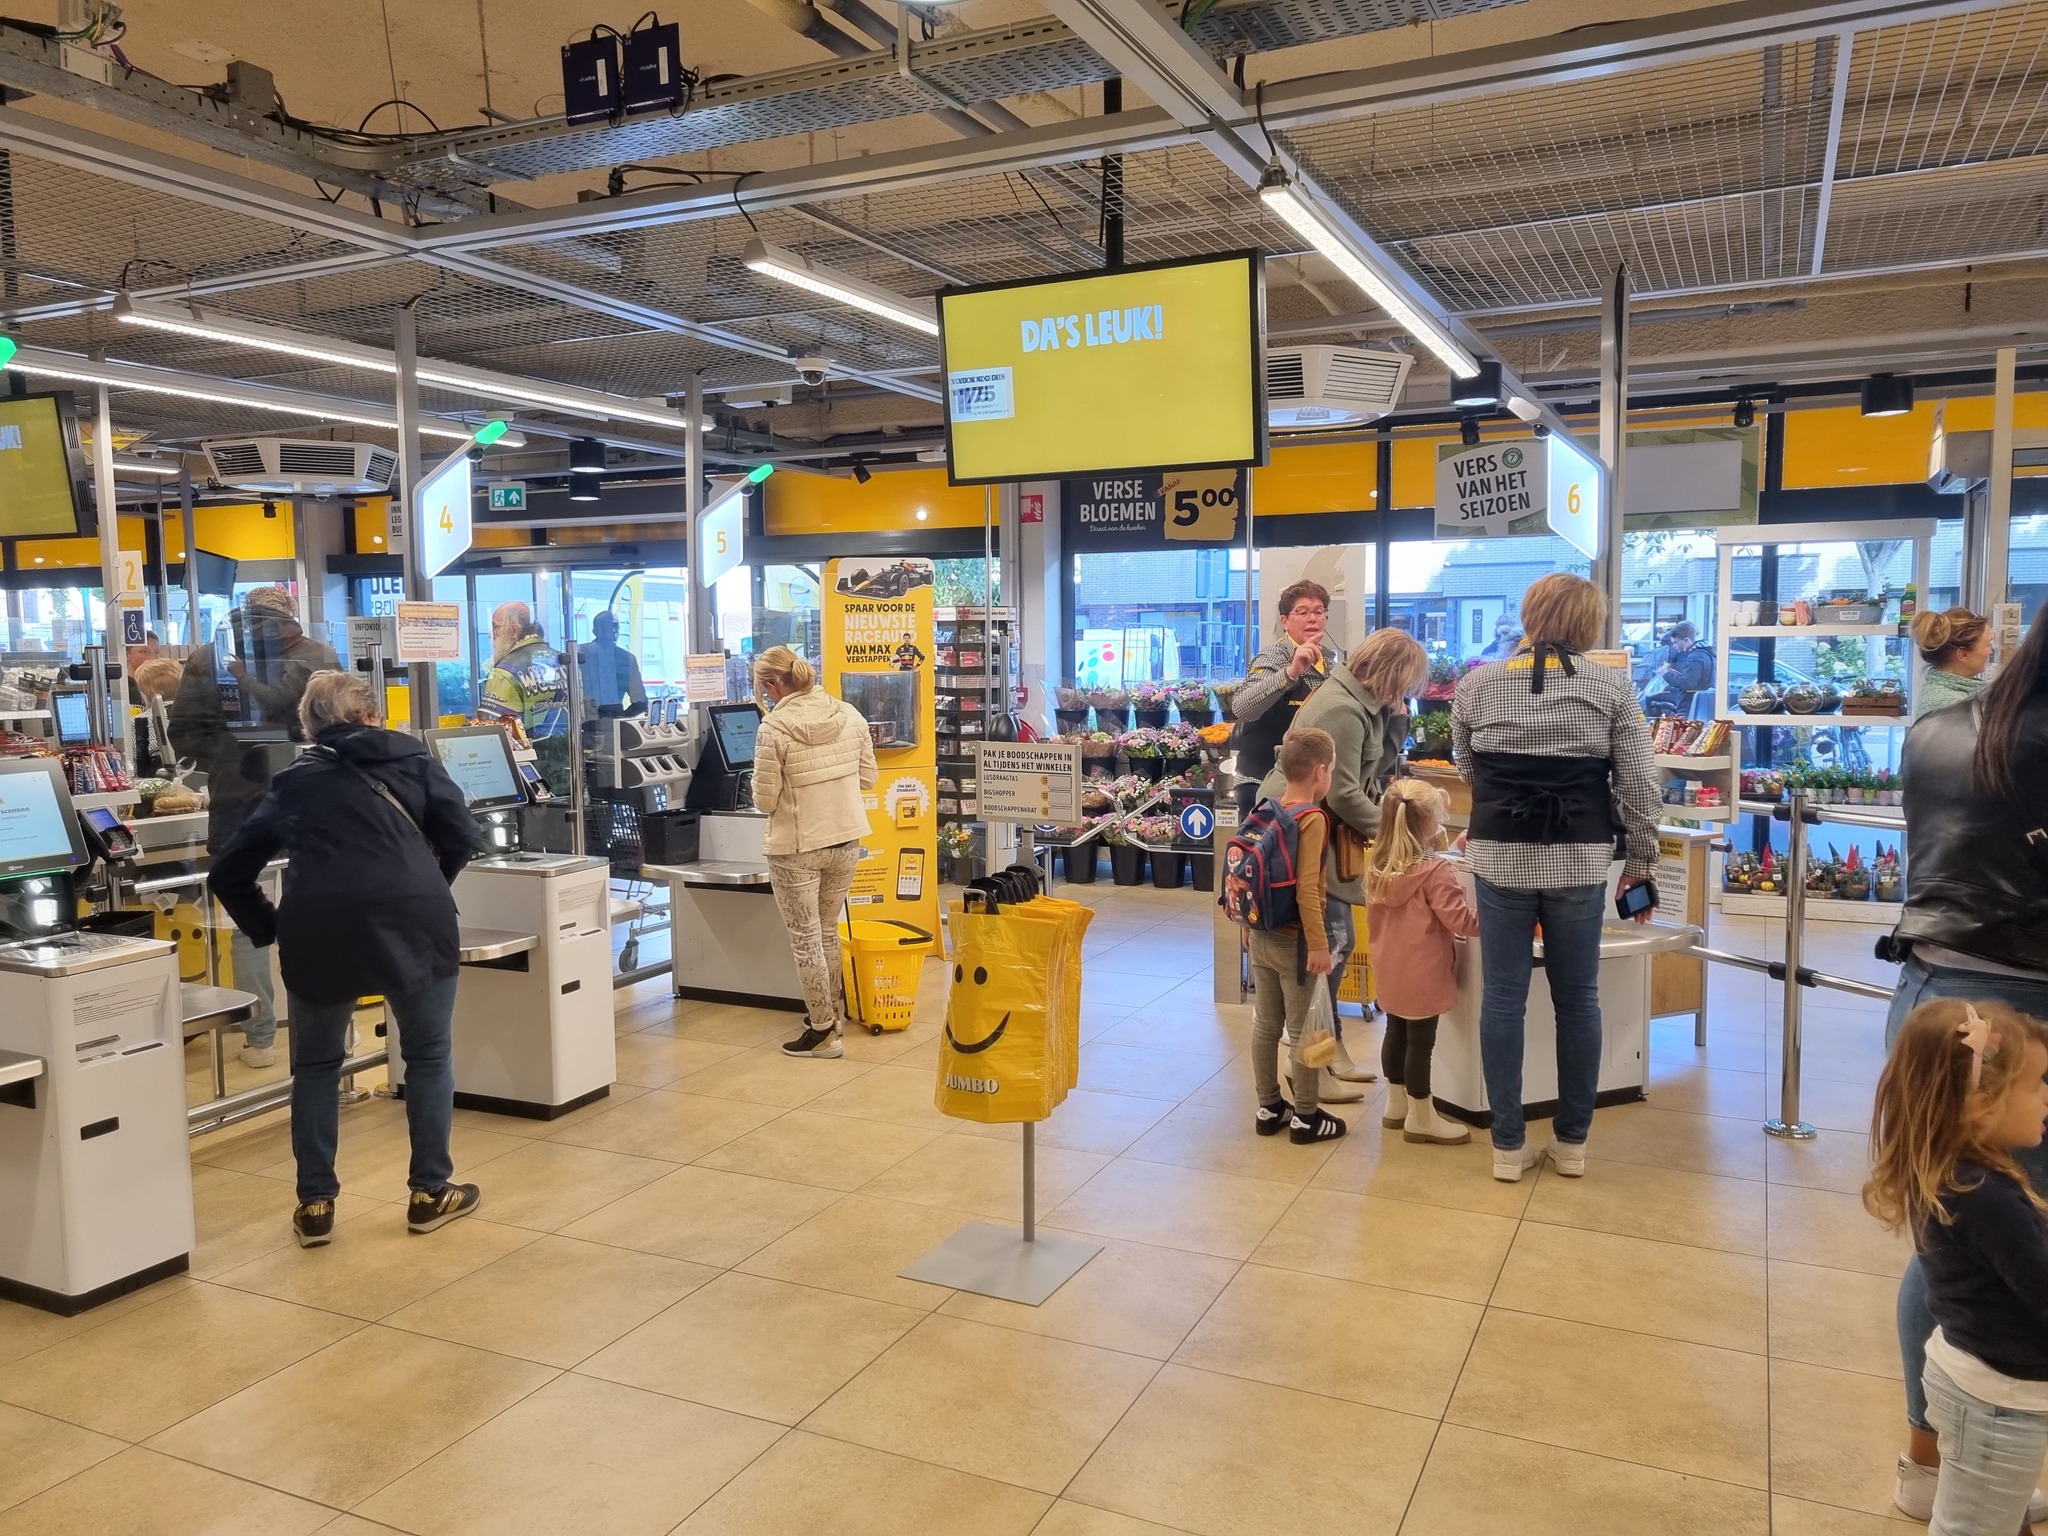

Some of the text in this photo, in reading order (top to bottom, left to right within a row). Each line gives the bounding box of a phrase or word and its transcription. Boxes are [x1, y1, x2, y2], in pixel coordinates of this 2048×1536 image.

[1020, 304, 1163, 353] DA'S LEUK!
[1453, 454, 1498, 479] VERS
[1092, 479, 1143, 500] VERSE
[1159, 478, 1182, 494] VANAF
[1456, 470, 1528, 500] VAN HET
[1459, 491, 1531, 520] SEIZOEN
[1567, 483, 1581, 515] 6
[439, 504, 454, 535] 4
[1080, 502, 1156, 523] BLOEMEN
[716, 530, 728, 554] 5
[125, 560, 137, 590] 2
[844, 603, 916, 613] SPAAR VOOR DE
[844, 613, 916, 629] NIEUWSTE
[844, 630, 918, 644] RACEAUTO
[845, 644, 891, 655] VAN MAX
[846, 655, 892, 663] VERSTAPPEN
[983, 749, 1072, 762] PAK JE BOODSCHAPPEN IN
[983, 760, 1072, 772] AL TIJDENS HET WINKELEN
[983, 774, 1019, 782] LUSDRAAGTAS
[983, 789, 1016, 797] BIGSHOPPER
[983, 804, 1037, 813] BOODSCHAPPENKRAT
[946, 1073, 1000, 1094] JUMBO
